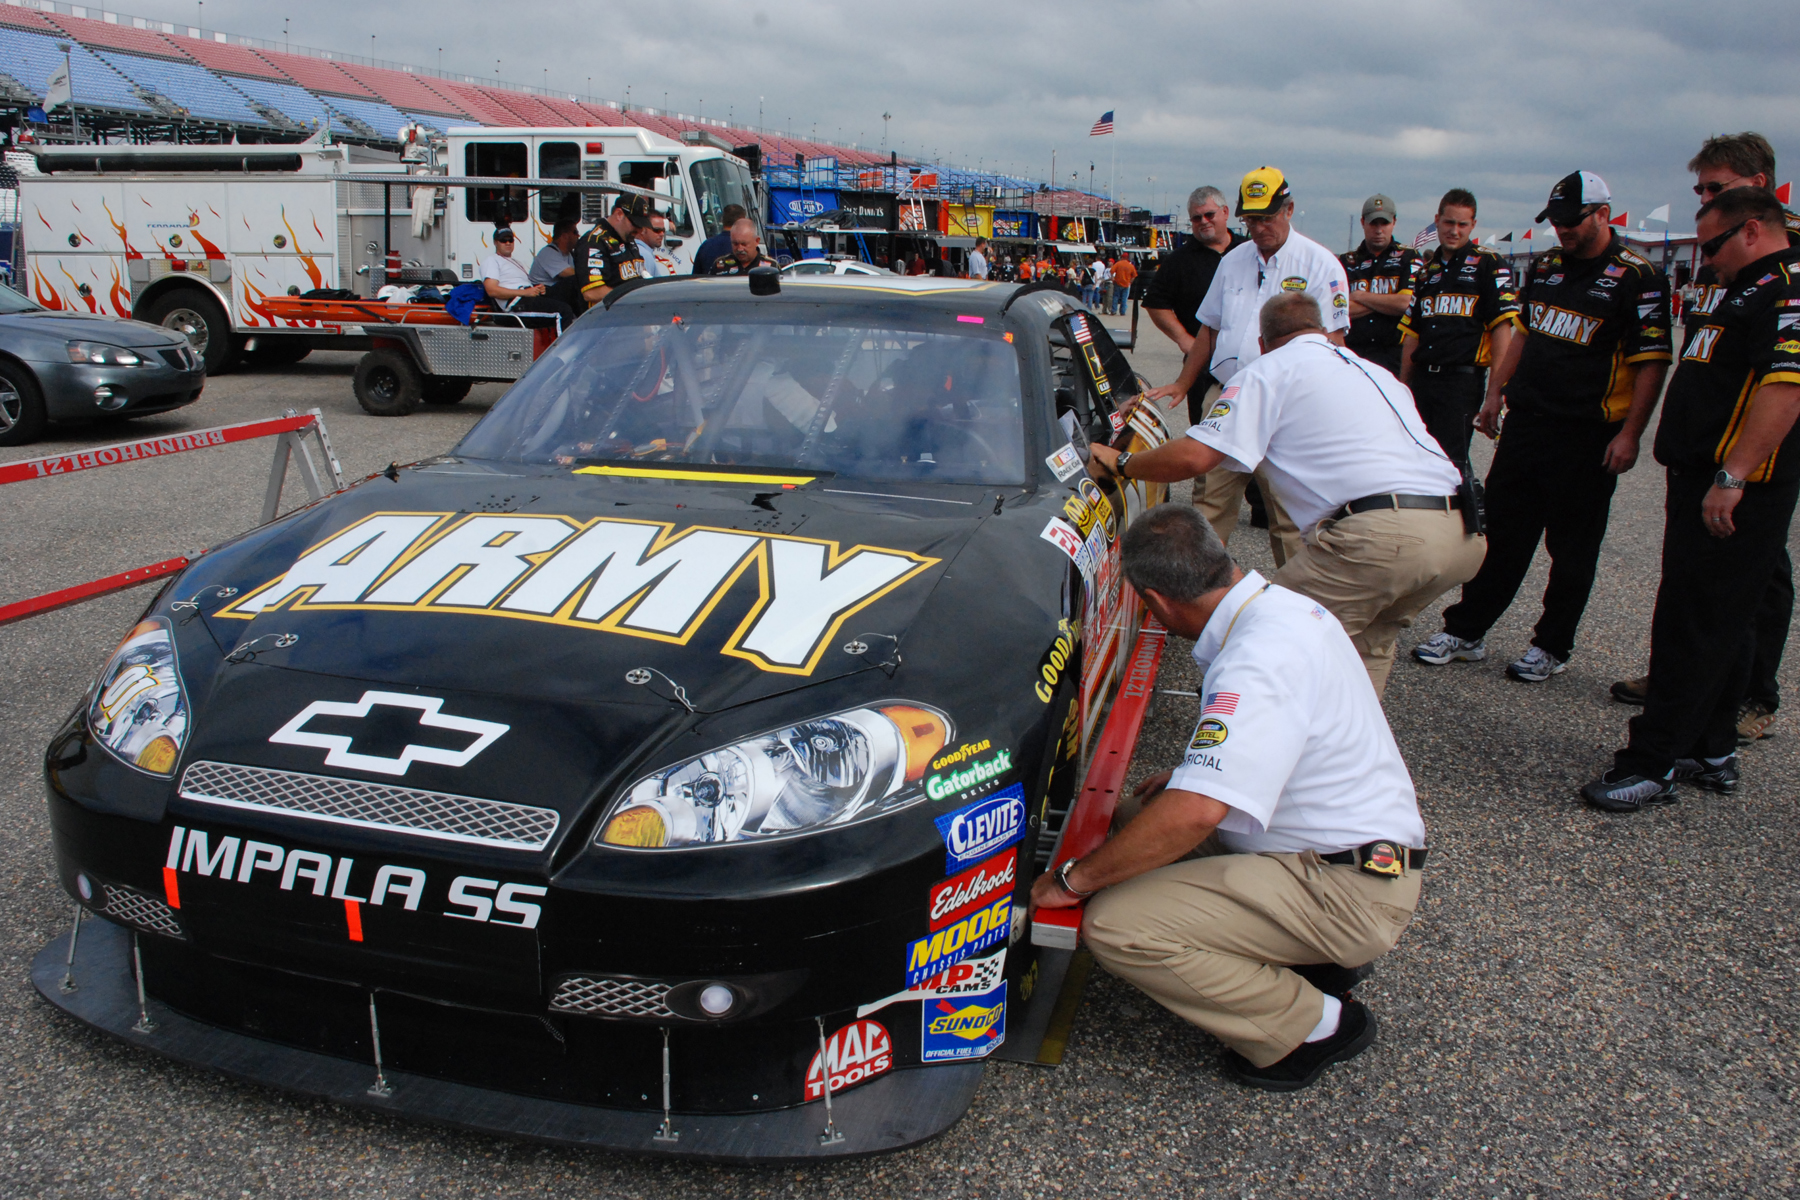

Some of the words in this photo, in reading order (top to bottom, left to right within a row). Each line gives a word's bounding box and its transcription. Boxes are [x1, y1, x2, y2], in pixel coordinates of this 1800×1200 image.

[1538, 308, 1599, 345] ARMY
[27, 430, 226, 477] BRUNNHOELZL
[225, 513, 928, 671] ARMY
[926, 750, 1012, 801] Gatorback
[932, 739, 991, 770] GOODYEAR
[961, 779, 999, 800] BELTS
[951, 799, 1018, 854] CLEVITE
[959, 843, 990, 860] ENGINE
[992, 829, 1016, 844] PARTS
[166, 826, 426, 911] IMPALA
[443, 876, 548, 929] SS
[930, 856, 1015, 920] Edelbrock
[908, 895, 1012, 972] MOOG
[912, 948, 966, 984] CHASSIS
[935, 979, 991, 994] CAMS
[932, 1006, 1003, 1032] SUNOCO
[808, 1022, 890, 1081] MAC
[808, 1055, 889, 1097] TOOLS
